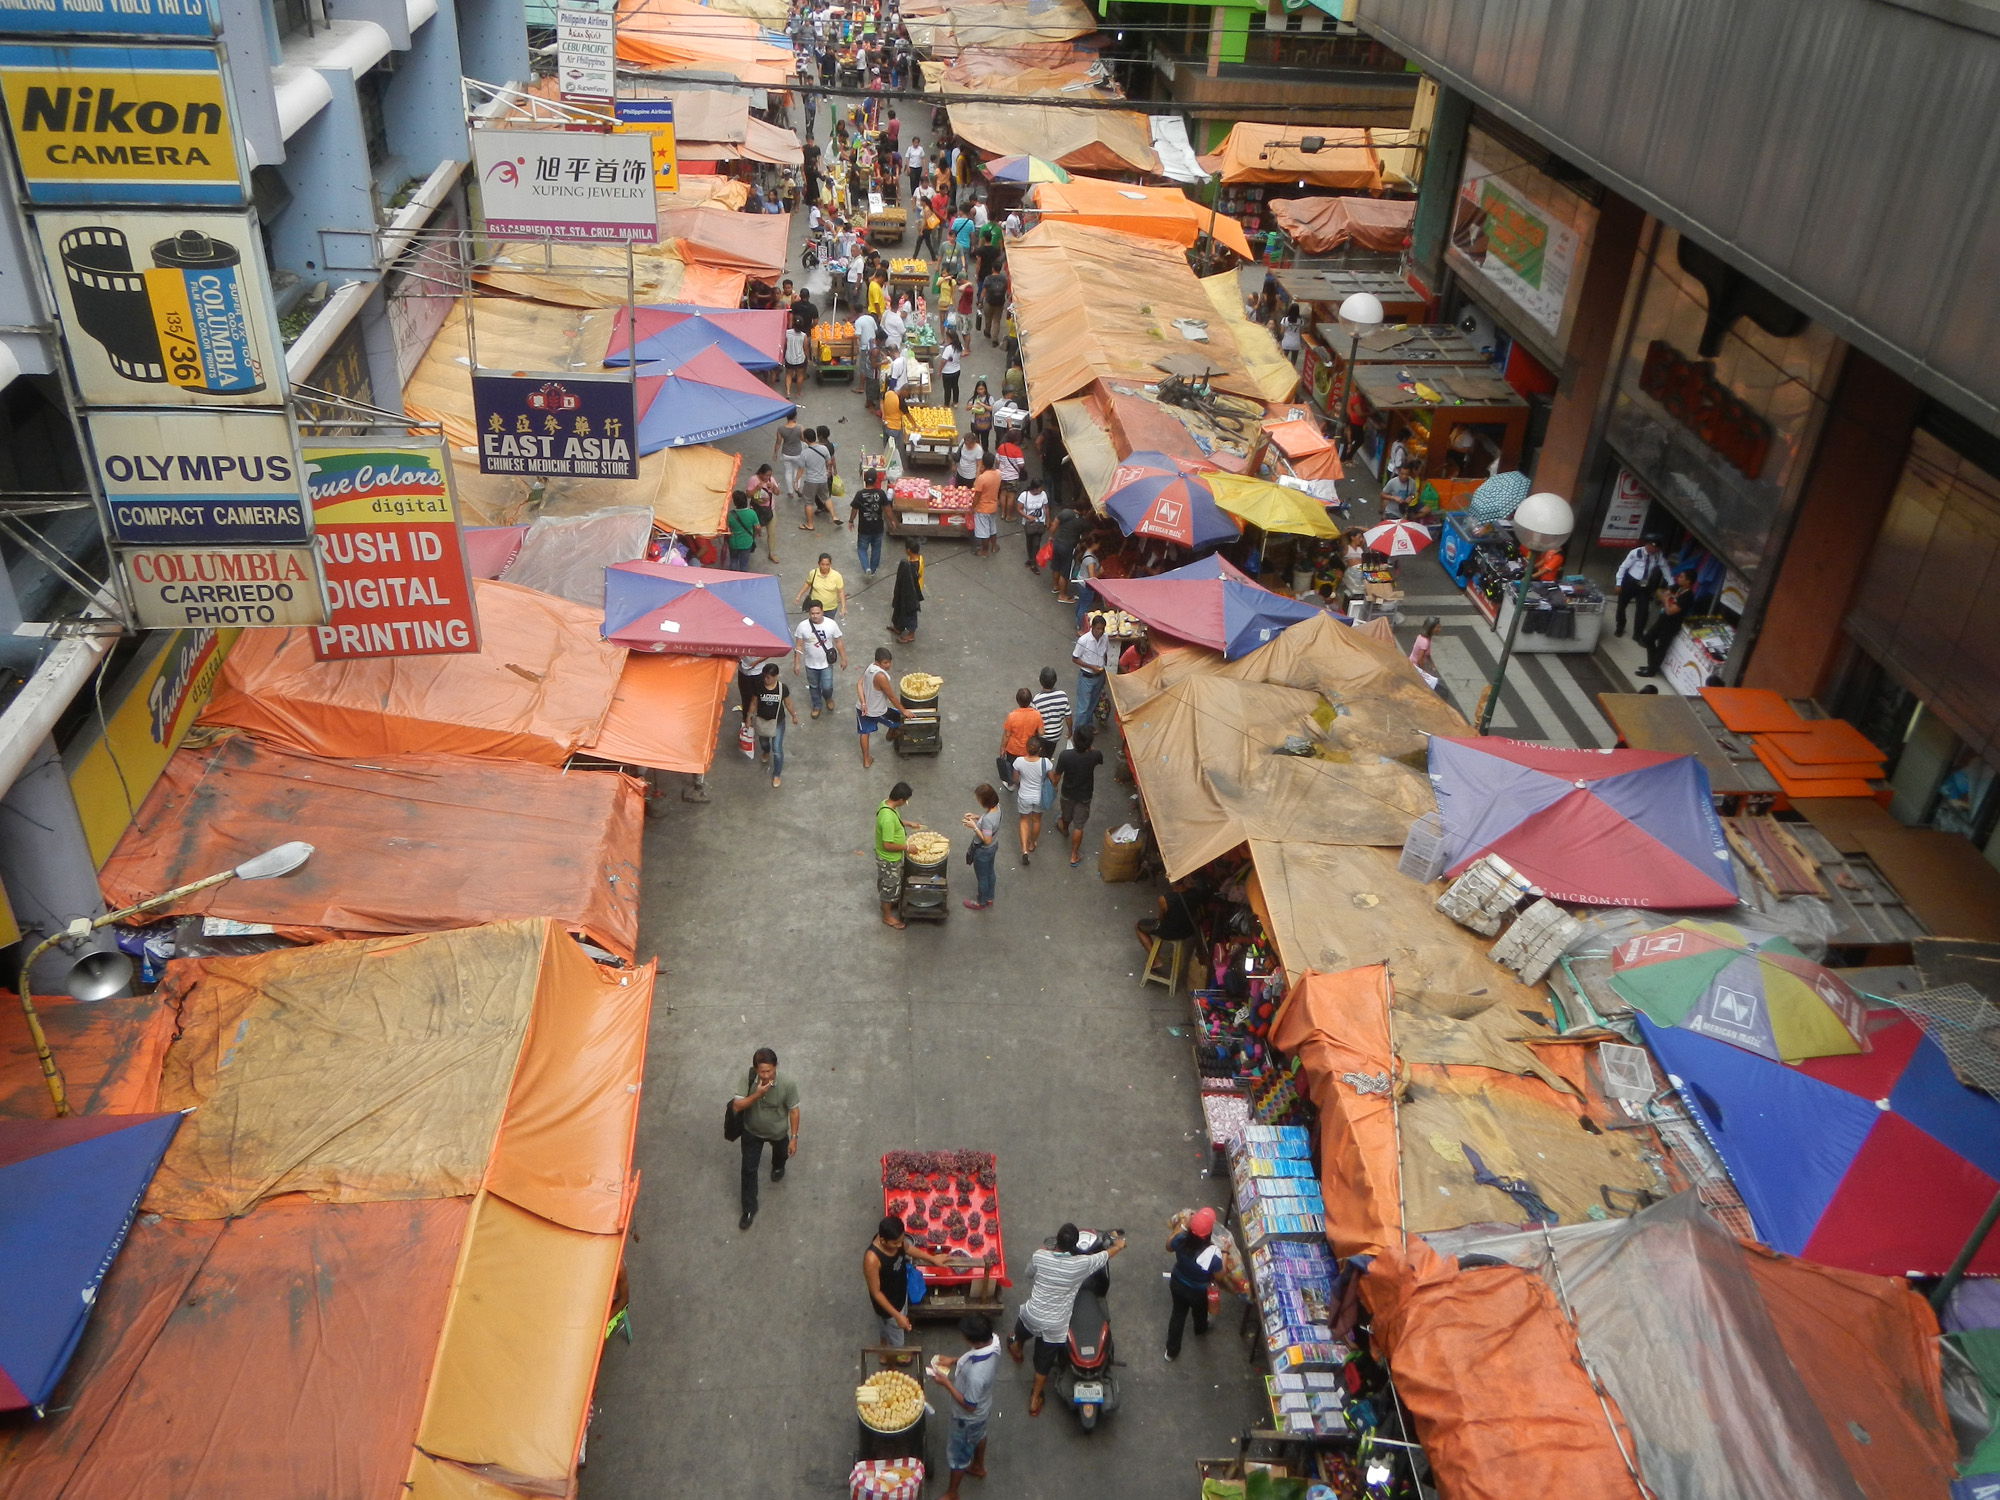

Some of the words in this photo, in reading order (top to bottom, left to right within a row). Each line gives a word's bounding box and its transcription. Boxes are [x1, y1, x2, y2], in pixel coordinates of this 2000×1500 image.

[588, 16, 608, 27] Airlines
[562, 42, 581, 52] CEBU
[582, 44, 608, 54] PACIFIC
[565, 55, 576, 63] Air
[22, 86, 222, 135] Nikon
[623, 109, 649, 117] Philippine
[46, 145, 211, 166] CAMERA
[535, 155, 647, 185] 旭平首饰
[532, 185, 584, 197] XUPING
[587, 187, 647, 199] JEWELRY
[619, 228, 653, 240] MANILA
[190, 281, 200, 301] FILM
[229, 283, 242, 315] SUPER
[195, 303, 204, 320] FOR
[198, 322, 211, 350] COLOR
[199, 275, 239, 387] COLUMBIA
[228, 312, 239, 341] GOLD
[205, 352, 217, 379] PRINTS
[688, 420, 749, 442] MICROMATIC
[483, 434, 555, 459] EAST
[564, 437, 630, 461] ASIA
[105, 455, 291, 482] OLYMPUS
[487, 457, 525, 472] CHINESE
[528, 459, 571, 474] MEDICINE
[574, 460, 598, 474] DRUG
[601, 461, 629, 476] STORE
[355, 464, 442, 492] Colors
[117, 507, 204, 527] COMPACT
[213, 506, 300, 526] CAMERAS
[372, 498, 448, 516] digital
[315, 531, 400, 565] RUSH
[409, 531, 443, 562] ID
[133, 553, 309, 584] COLUMBIA
[160, 584, 293, 604] CARRIEDO
[327, 576, 450, 610] DIGITAL
[186, 604, 275, 624] PHOTO
[318, 618, 470, 655] PRINTING
[673, 643, 756, 655] MICROMATIC
[192, 649, 222, 703] digital
[149, 675, 182, 742] True
[1550, 891, 1649, 907] MICROMATIC
